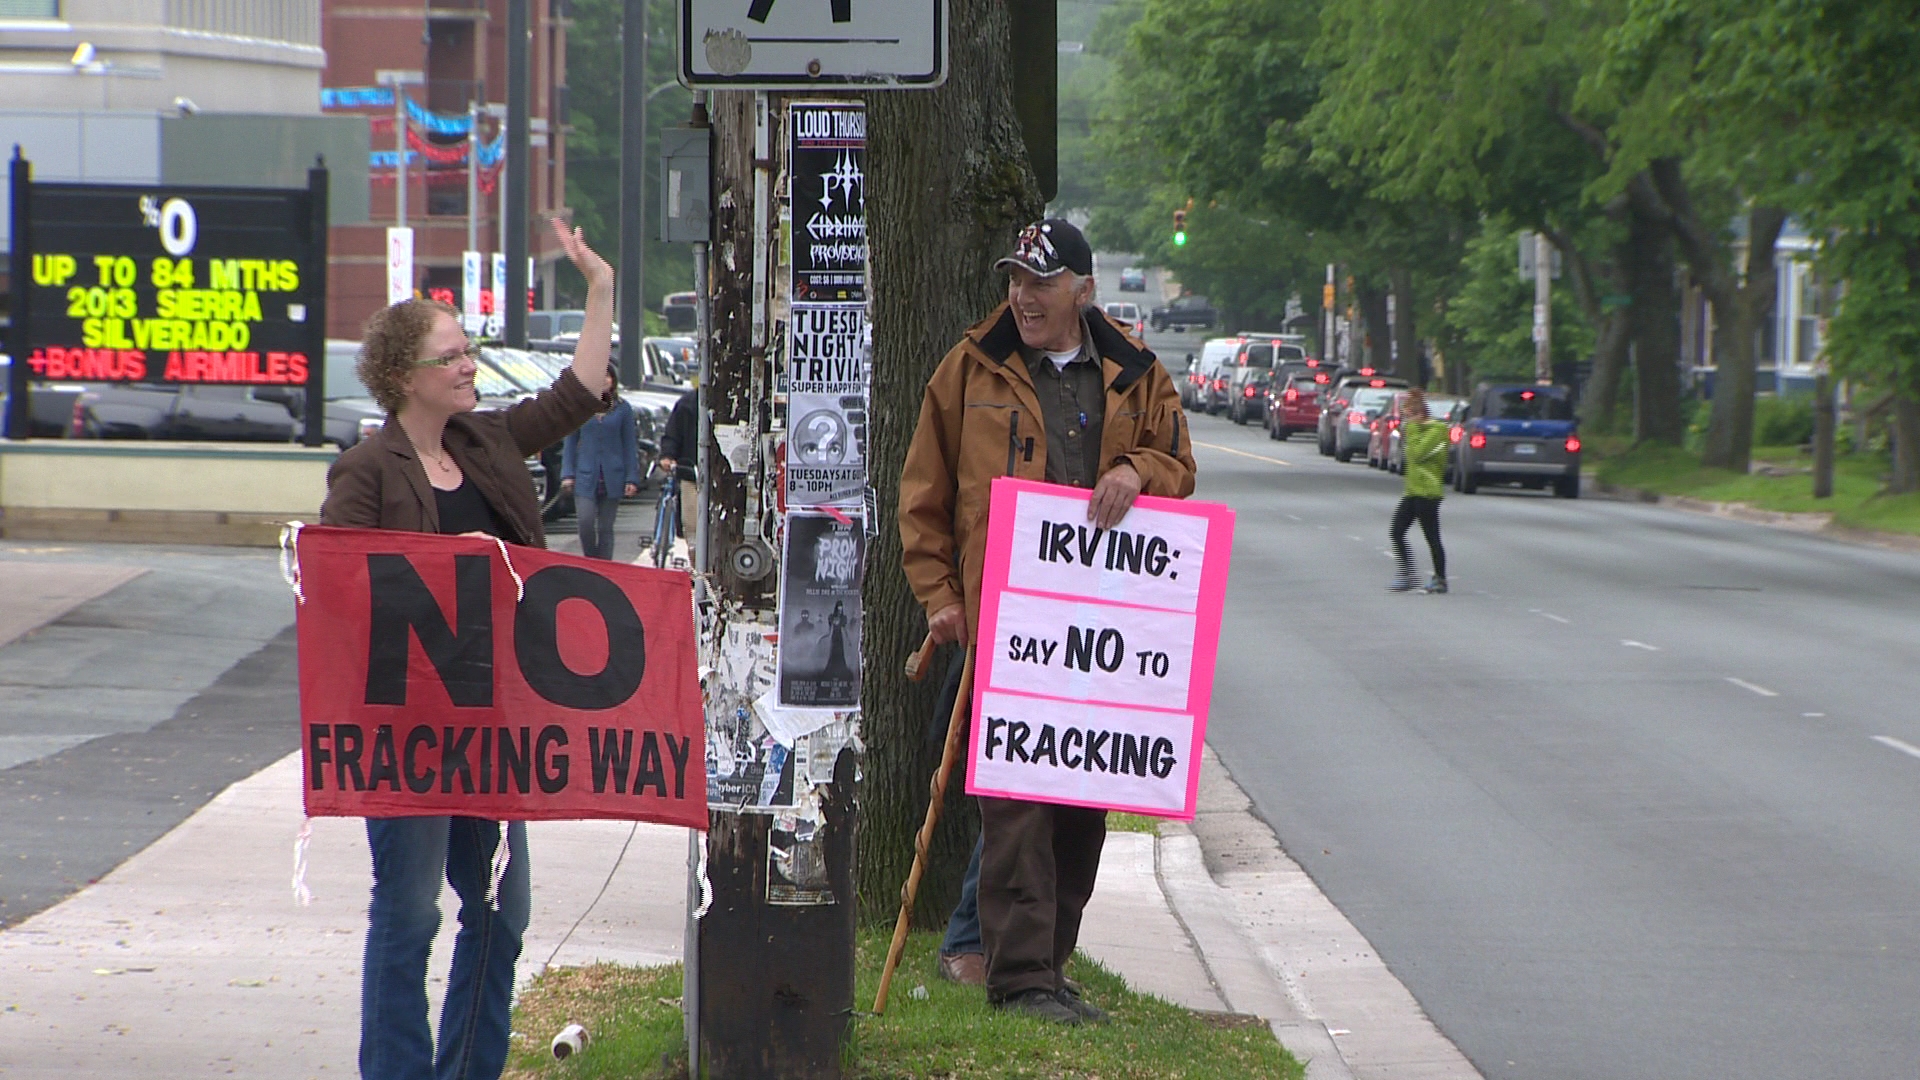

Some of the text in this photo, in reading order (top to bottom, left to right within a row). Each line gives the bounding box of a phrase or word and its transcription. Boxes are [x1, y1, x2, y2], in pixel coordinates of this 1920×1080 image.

[796, 110, 830, 138] LOUD
[32, 254, 299, 291] UP TO 84 MTHS
[66, 286, 263, 321] 2013 SIERRA
[82, 319, 250, 351] SILVERADO
[793, 333, 856, 358] NIGHT
[163, 350, 309, 385] AIRMILES
[792, 358, 860, 382] TRIVIA
[791, 382, 824, 393] SUPER
[826, 382, 851, 394] HAPPY
[789, 481, 796, 492] 8
[806, 481, 832, 492] 10PM
[790, 469, 839, 480] TUESDAYS
[817, 536, 857, 559] PROM
[1038, 520, 1181, 580] IRVING:
[815, 556, 857, 583] NIGHT
[364, 552, 645, 710] NO
[1008, 625, 1169, 678] SAY NO TO
[309, 723, 691, 800] FRACKING WAY
[984, 716, 1177, 779] FRACKING
